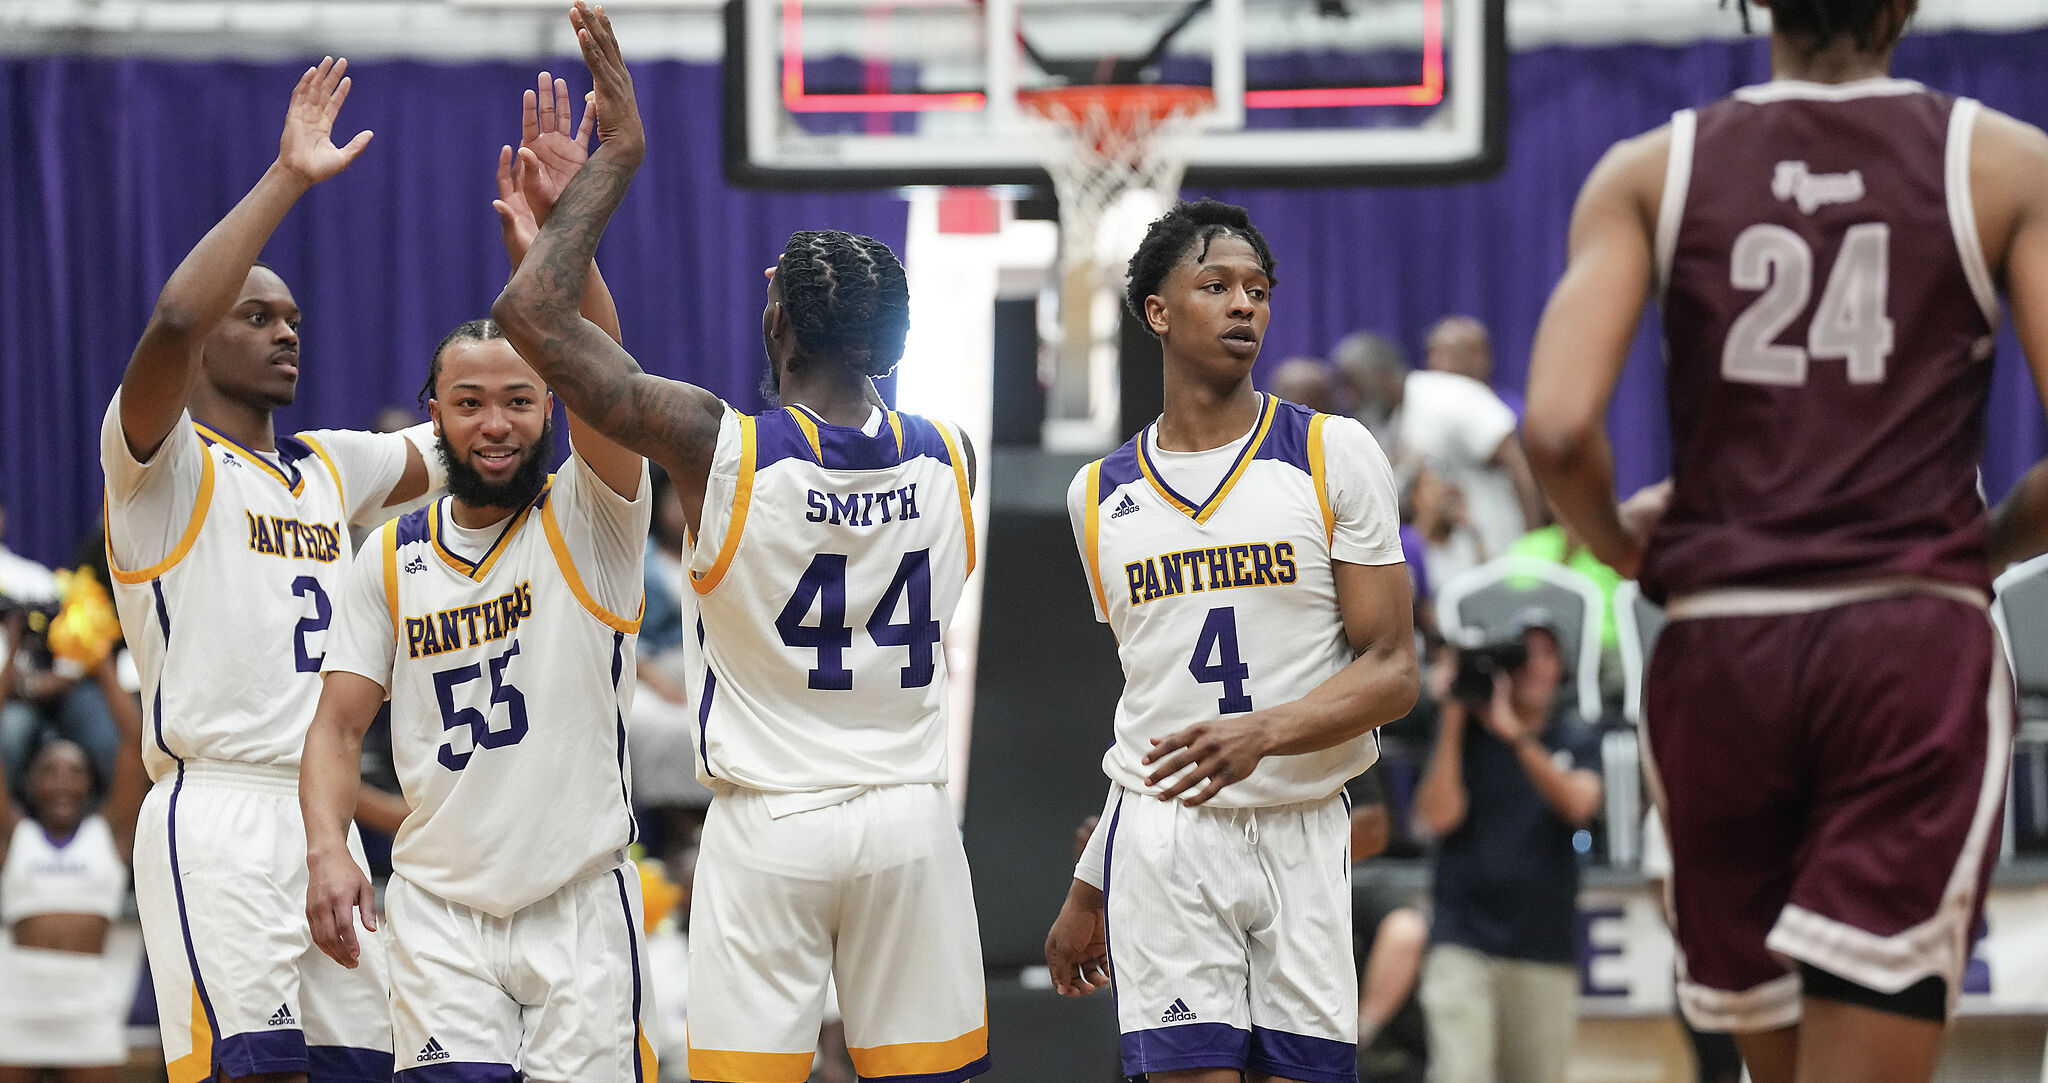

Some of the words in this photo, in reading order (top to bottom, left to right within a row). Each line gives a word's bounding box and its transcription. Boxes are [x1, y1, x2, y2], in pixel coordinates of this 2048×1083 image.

[1720, 221, 1895, 387] 24
[245, 508, 340, 563] PANTHER
[806, 483, 920, 527] SMITH
[1111, 504, 1140, 519] adidas
[1124, 540, 1298, 607] PANTHERS
[291, 575, 333, 672] 2
[774, 547, 941, 690] 44
[1188, 606, 1253, 715] 4
[432, 638, 529, 772] 55
[268, 1016, 296, 1026] adidas
[1161, 1012, 1197, 1023] adidas
[416, 1049, 450, 1062] adidas
